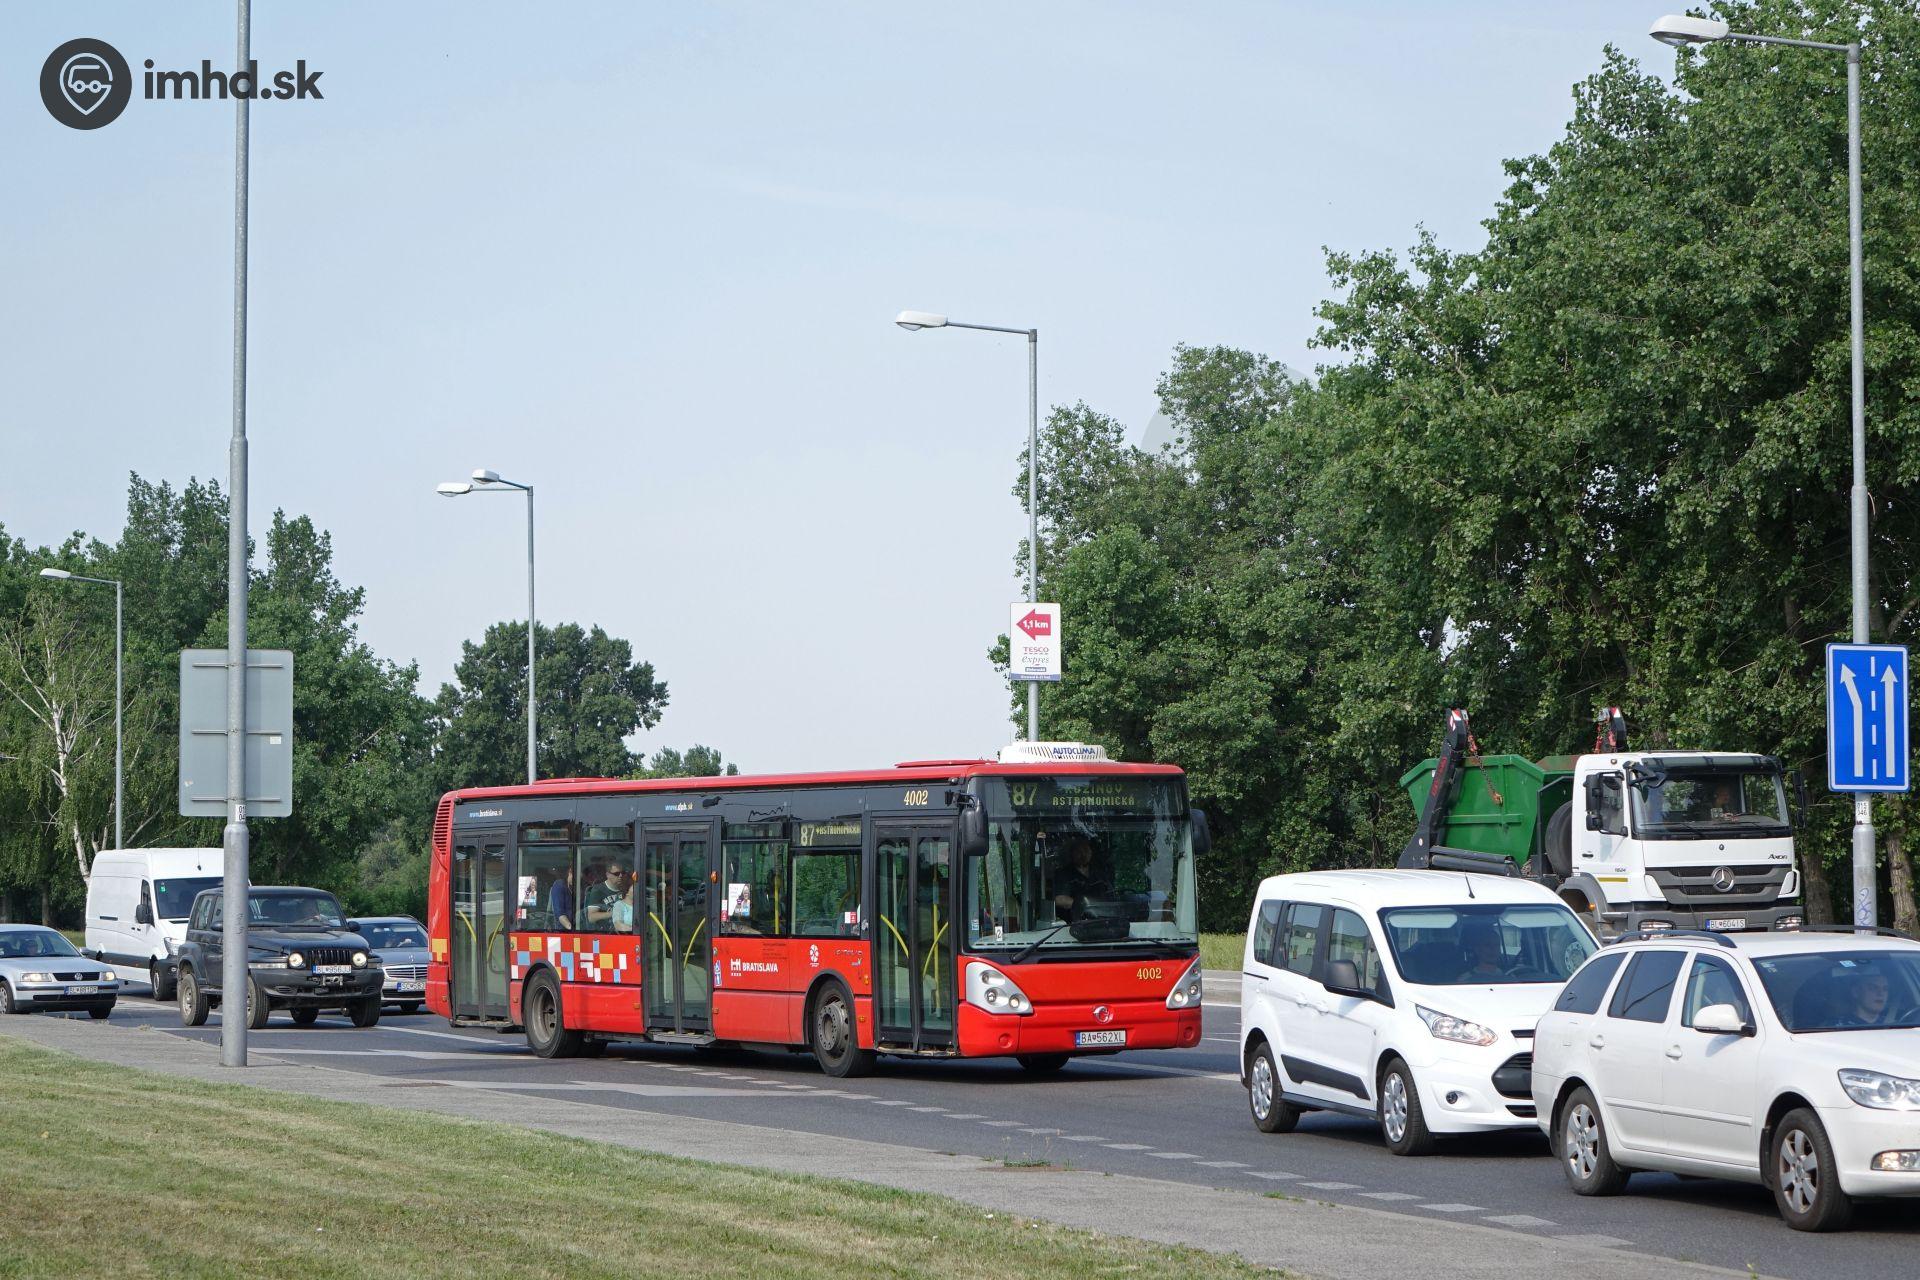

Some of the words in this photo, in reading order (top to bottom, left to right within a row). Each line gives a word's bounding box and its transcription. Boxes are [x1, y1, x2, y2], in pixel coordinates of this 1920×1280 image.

[1022, 620, 1034, 629] 1,1
[1035, 620, 1048, 628] km
[1053, 747, 1096, 755] AUTOCLIMA
[903, 790, 929, 806] 4002
[1012, 783, 1038, 806] 87
[800, 824, 815, 847] 87
[742, 962, 779, 973] BRATISLAVA
[1136, 967, 1162, 980] 4002
